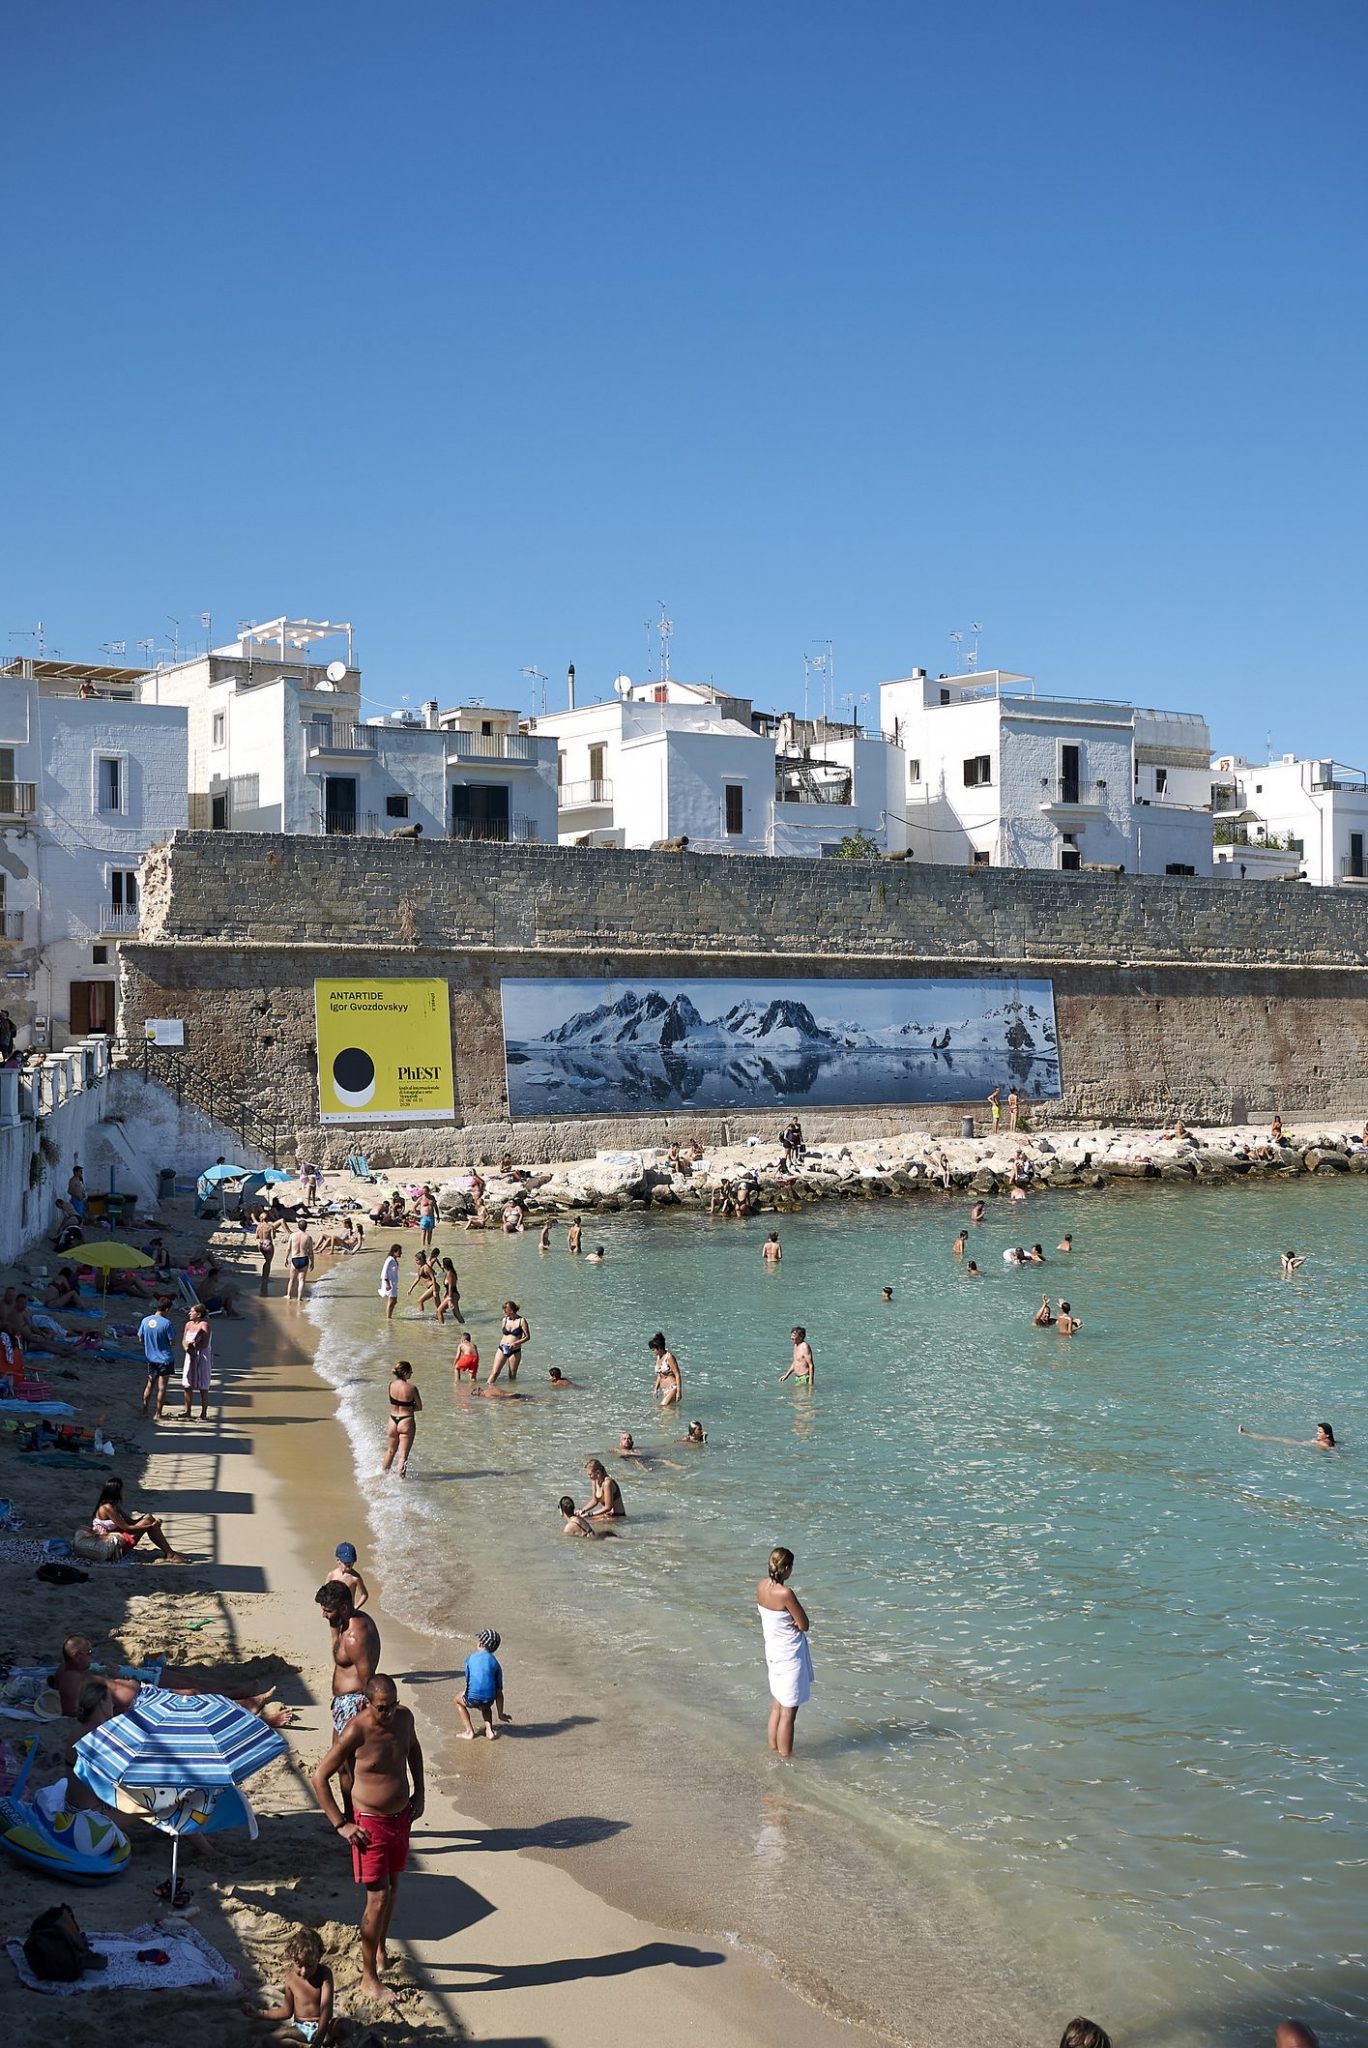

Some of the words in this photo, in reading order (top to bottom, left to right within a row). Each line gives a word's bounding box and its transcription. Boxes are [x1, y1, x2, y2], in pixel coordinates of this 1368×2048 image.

[330, 992, 383, 1000] ANTARTIDE
[330, 1003, 347, 1012] Igor
[350, 1003, 408, 1012] Gvozdovskyy
[398, 1066, 441, 1080] PhEST
